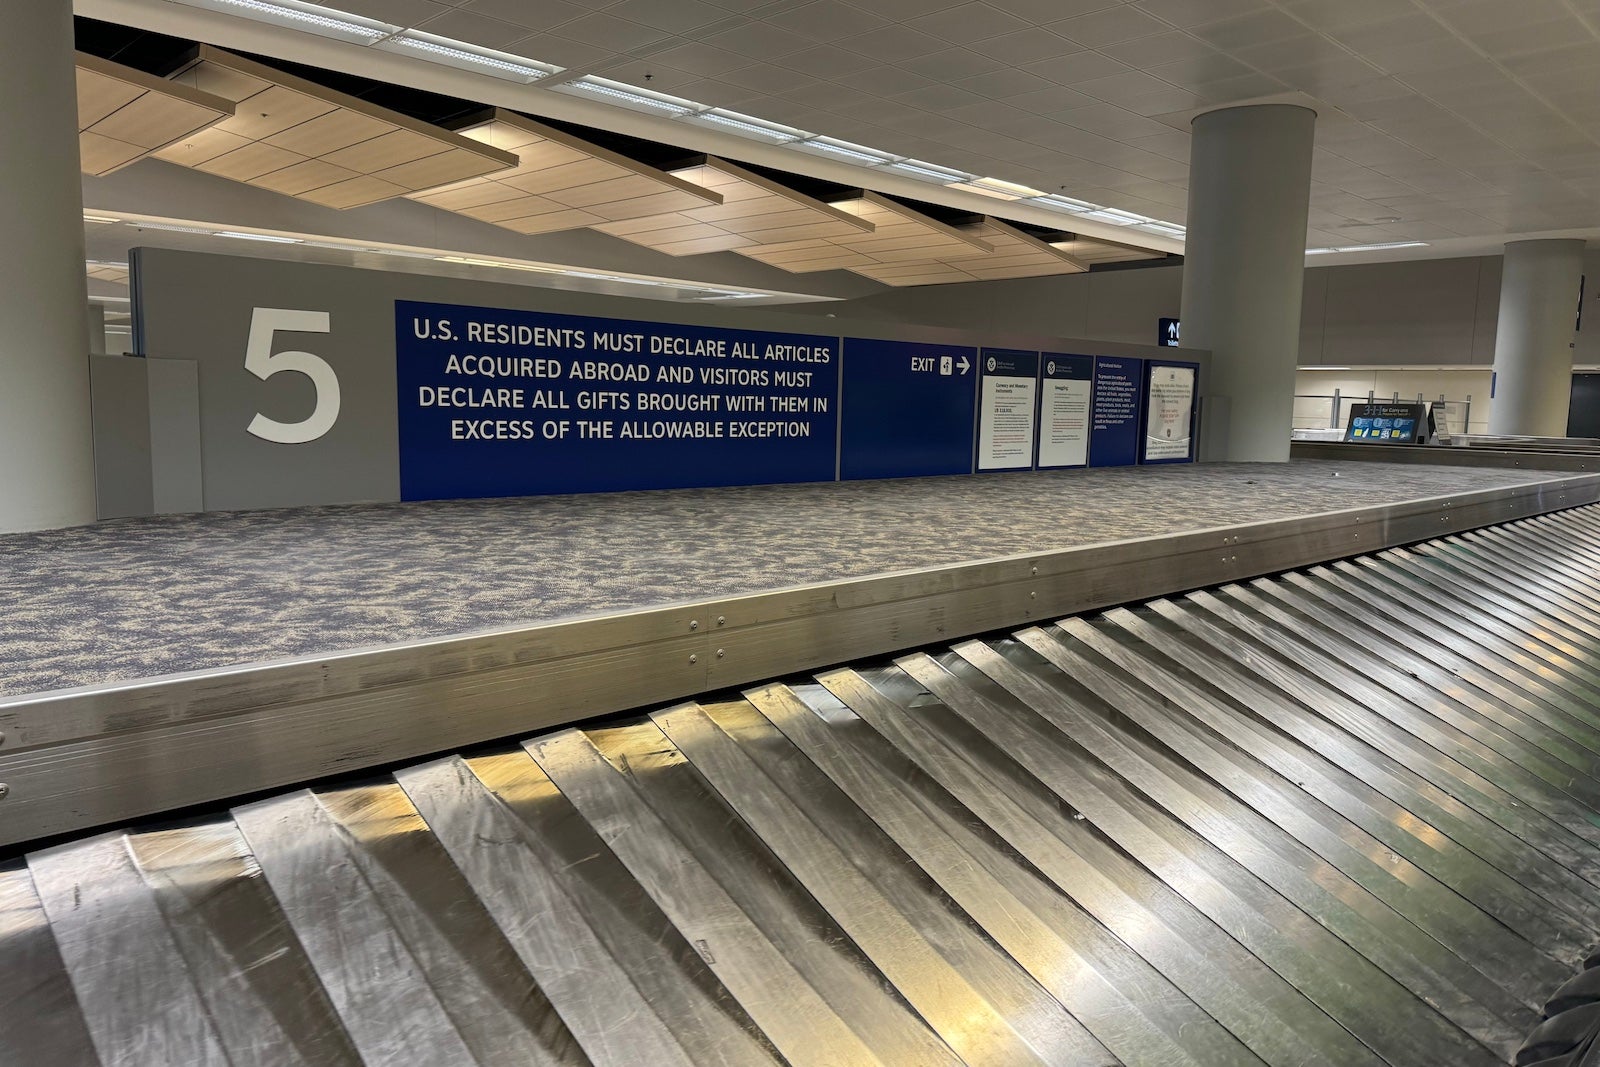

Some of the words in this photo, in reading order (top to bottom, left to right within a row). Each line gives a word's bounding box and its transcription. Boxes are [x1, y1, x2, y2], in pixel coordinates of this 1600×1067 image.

[415, 318, 458, 340] U.S.
[468, 322, 585, 348] RESIDENTS
[594, 332, 643, 352] MUST
[651, 336, 725, 357] DECLARE
[732, 342, 759, 359] ALL
[765, 345, 829, 363] ARTICLES
[245, 307, 341, 444] 5
[445, 355, 561, 378] ACQUIRED
[569, 361, 649, 381] ABROAD
[657, 366, 693, 383] AND
[700, 368, 768, 386] VISITORS
[775, 371, 812, 387] MUST
[911, 357, 935, 372] EXIT
[420, 387, 524, 408] DECLARE
[532, 390, 569, 408] ALL
[577, 392, 630, 410] GIFTS
[638, 393, 720, 411] BROUGHT
[726, 396, 764, 411] WITH
[770, 397, 808, 412] THEM
[814, 398, 827, 412] IN
[452, 420, 534, 439] EXCESS
[543, 421, 569, 439] OF
[577, 421, 613, 438] THE
[620, 422, 723, 438] ALLOWABLE
[730, 422, 809, 437] EXCEPTION
